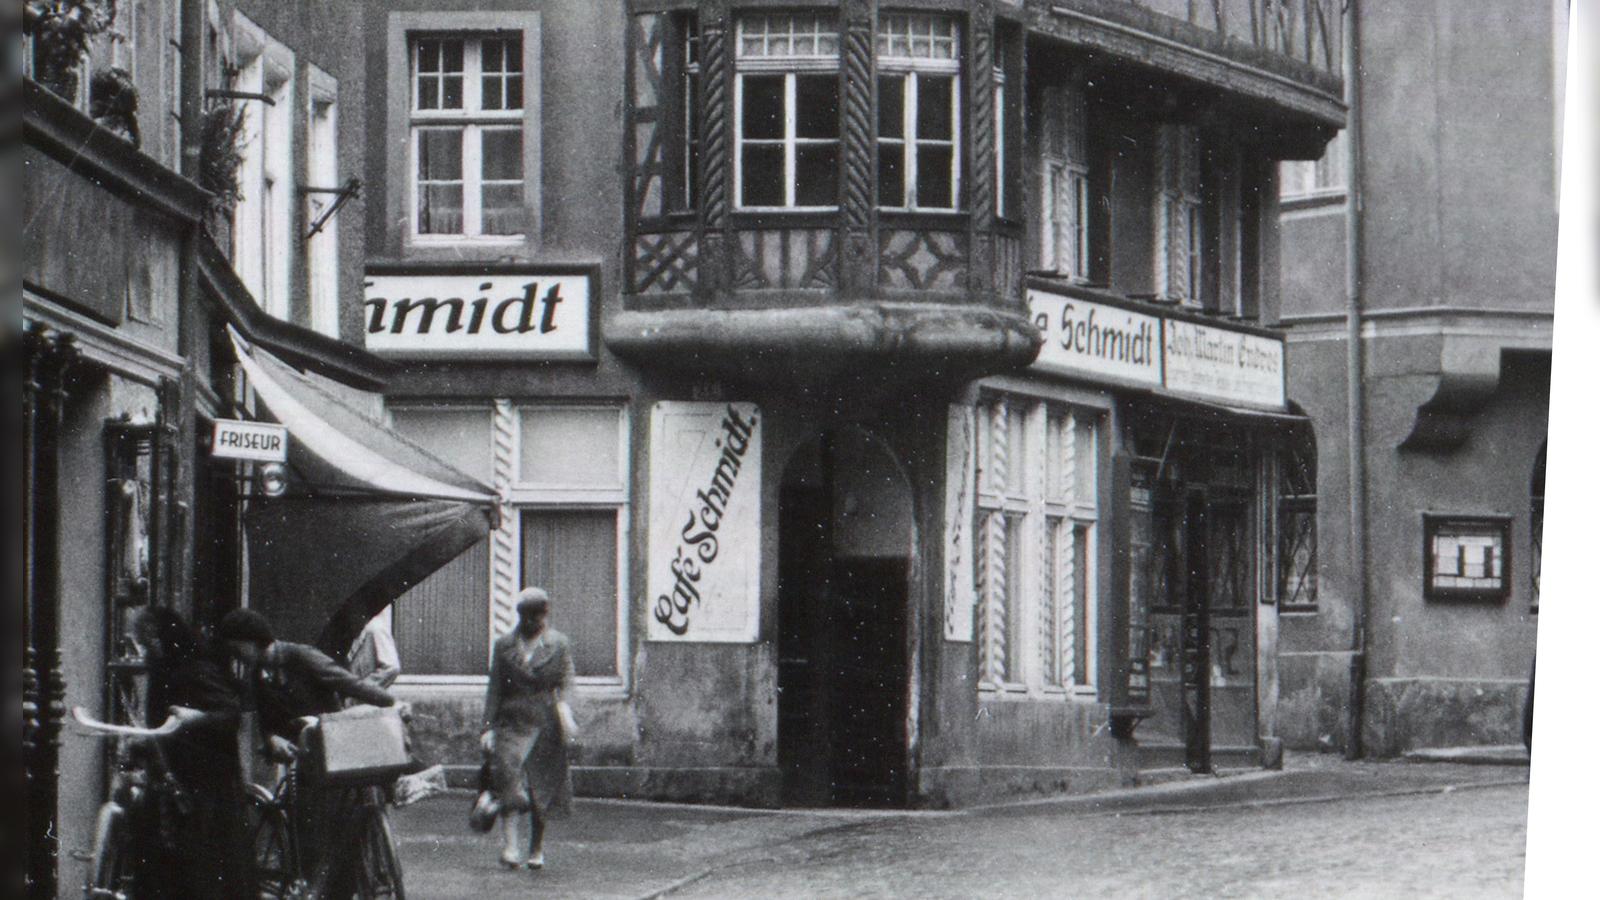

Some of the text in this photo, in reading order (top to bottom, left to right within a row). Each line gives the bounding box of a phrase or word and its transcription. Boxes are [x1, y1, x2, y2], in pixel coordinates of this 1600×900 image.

[1061, 302, 1152, 367] Schmidt
[219, 430, 281, 452] FRISEUR
[655, 546, 701, 636] Café
